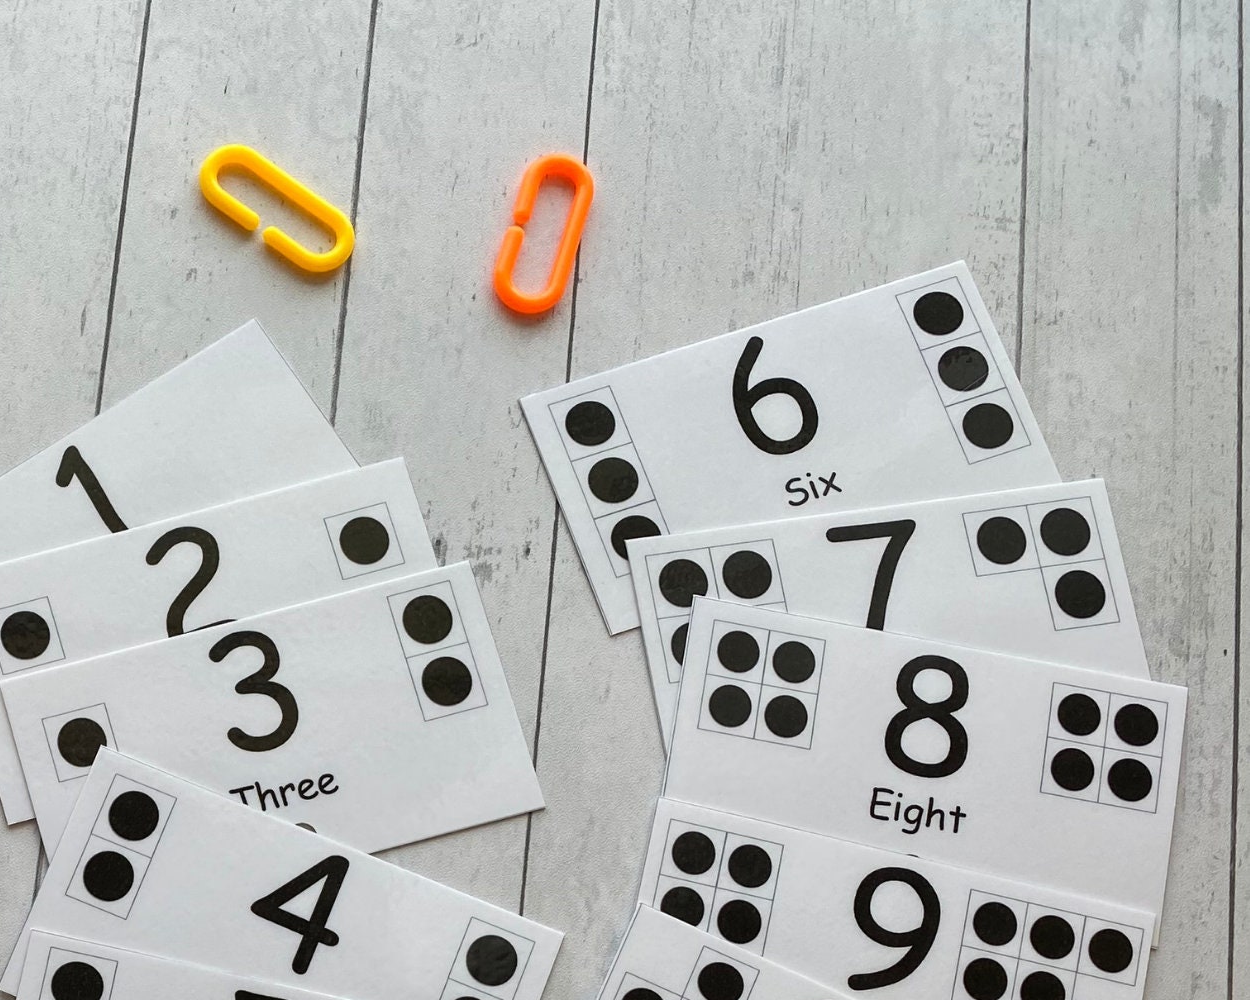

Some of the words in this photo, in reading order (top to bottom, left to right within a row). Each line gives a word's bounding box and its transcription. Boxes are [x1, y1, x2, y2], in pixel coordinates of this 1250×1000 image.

[733, 336, 819, 455] 6
[55, 445, 129, 534] 1
[785, 472, 842, 507] Six
[145, 526, 236, 638] 2
[825, 519, 917, 632] 7
[208, 630, 299, 753] 3
[884, 654, 970, 779] 8
[228, 773, 340, 812] Three
[869, 786, 968, 835] Eight
[250, 855, 350, 975] 4
[847, 866, 941, 991] 9
